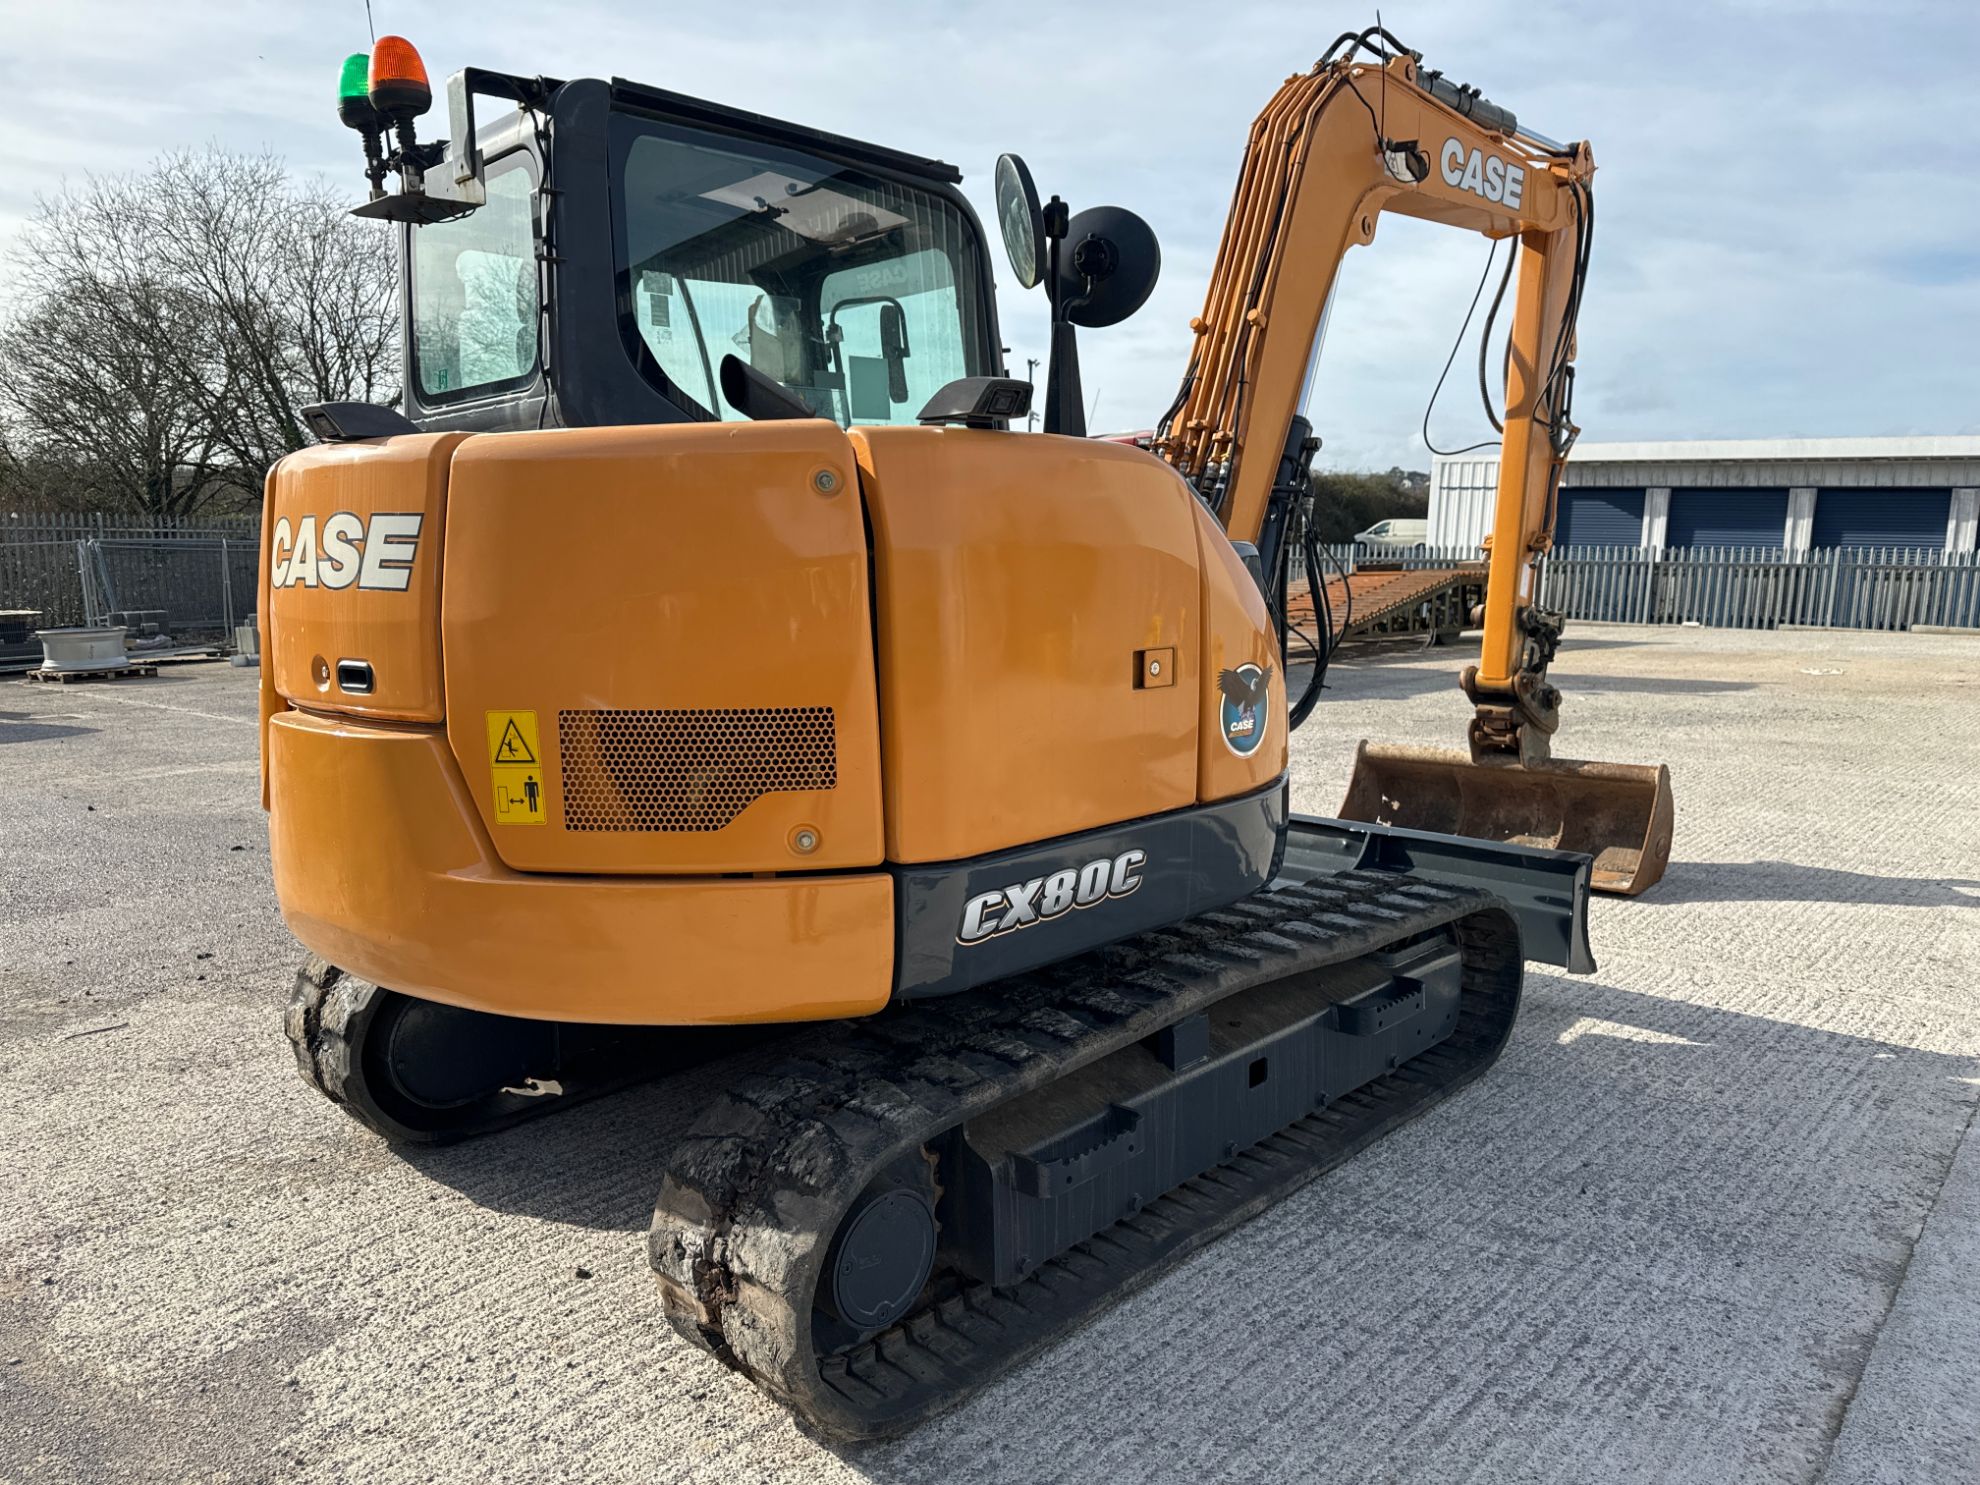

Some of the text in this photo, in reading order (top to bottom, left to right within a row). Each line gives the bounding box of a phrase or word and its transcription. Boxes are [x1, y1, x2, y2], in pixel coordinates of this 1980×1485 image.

[1440, 136, 1525, 211] CASE
[271, 511, 424, 592] CASE
[1230, 719, 1255, 732] CASE
[955, 848, 1147, 946] CX80C
